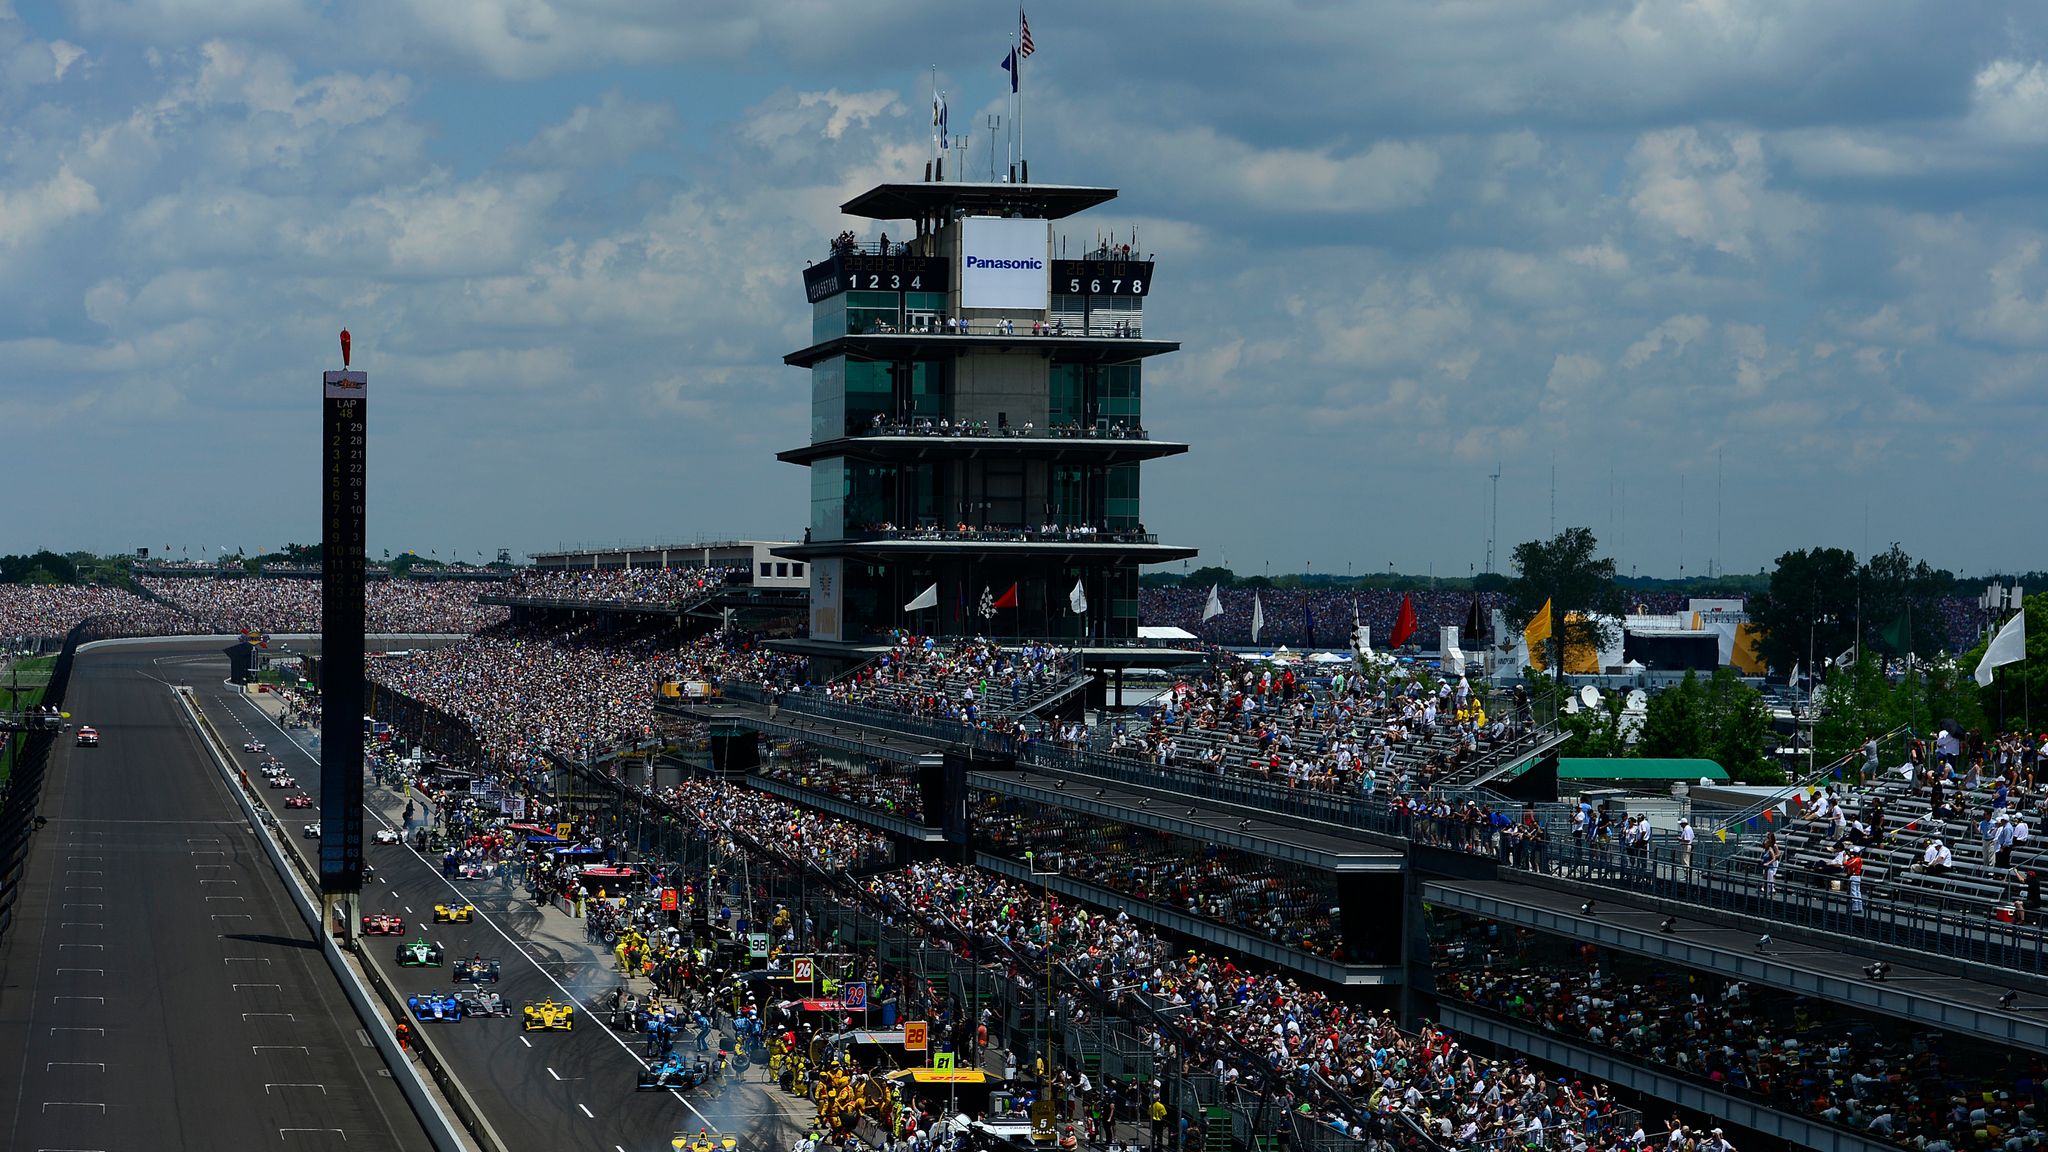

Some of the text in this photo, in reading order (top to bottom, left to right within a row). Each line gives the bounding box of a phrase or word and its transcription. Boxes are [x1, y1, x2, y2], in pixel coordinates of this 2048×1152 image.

[967, 256, 1042, 270] Panasonic
[849, 274, 921, 289] 1 2 3 4
[1070, 279, 1142, 294] 5 6 7 8
[337, 400, 357, 408] LAP
[339, 409, 353, 418] 48
[336, 422, 363, 432] 1 29
[333, 435, 363, 446] 2 28
[333, 449, 362, 460] 3 21
[332, 463, 362, 473] 4 22
[332, 477, 362, 488] 5 26
[332, 491, 359, 501] 6 5
[333, 505, 362, 514] 7 10
[332, 518, 359, 529] 8 7
[332, 532, 359, 543] 9 3
[331, 545, 362, 556] 10 98
[351, 560, 363, 569] 12
[559, 828, 569, 836] 27
[752, 940, 767, 951] 98
[796, 963, 811, 977] 26
[847, 987, 864, 1005] 29
[907, 1029, 924, 1043] 28
[937, 1058, 950, 1068] 21
[1040, 1119, 1047, 1128] 5
